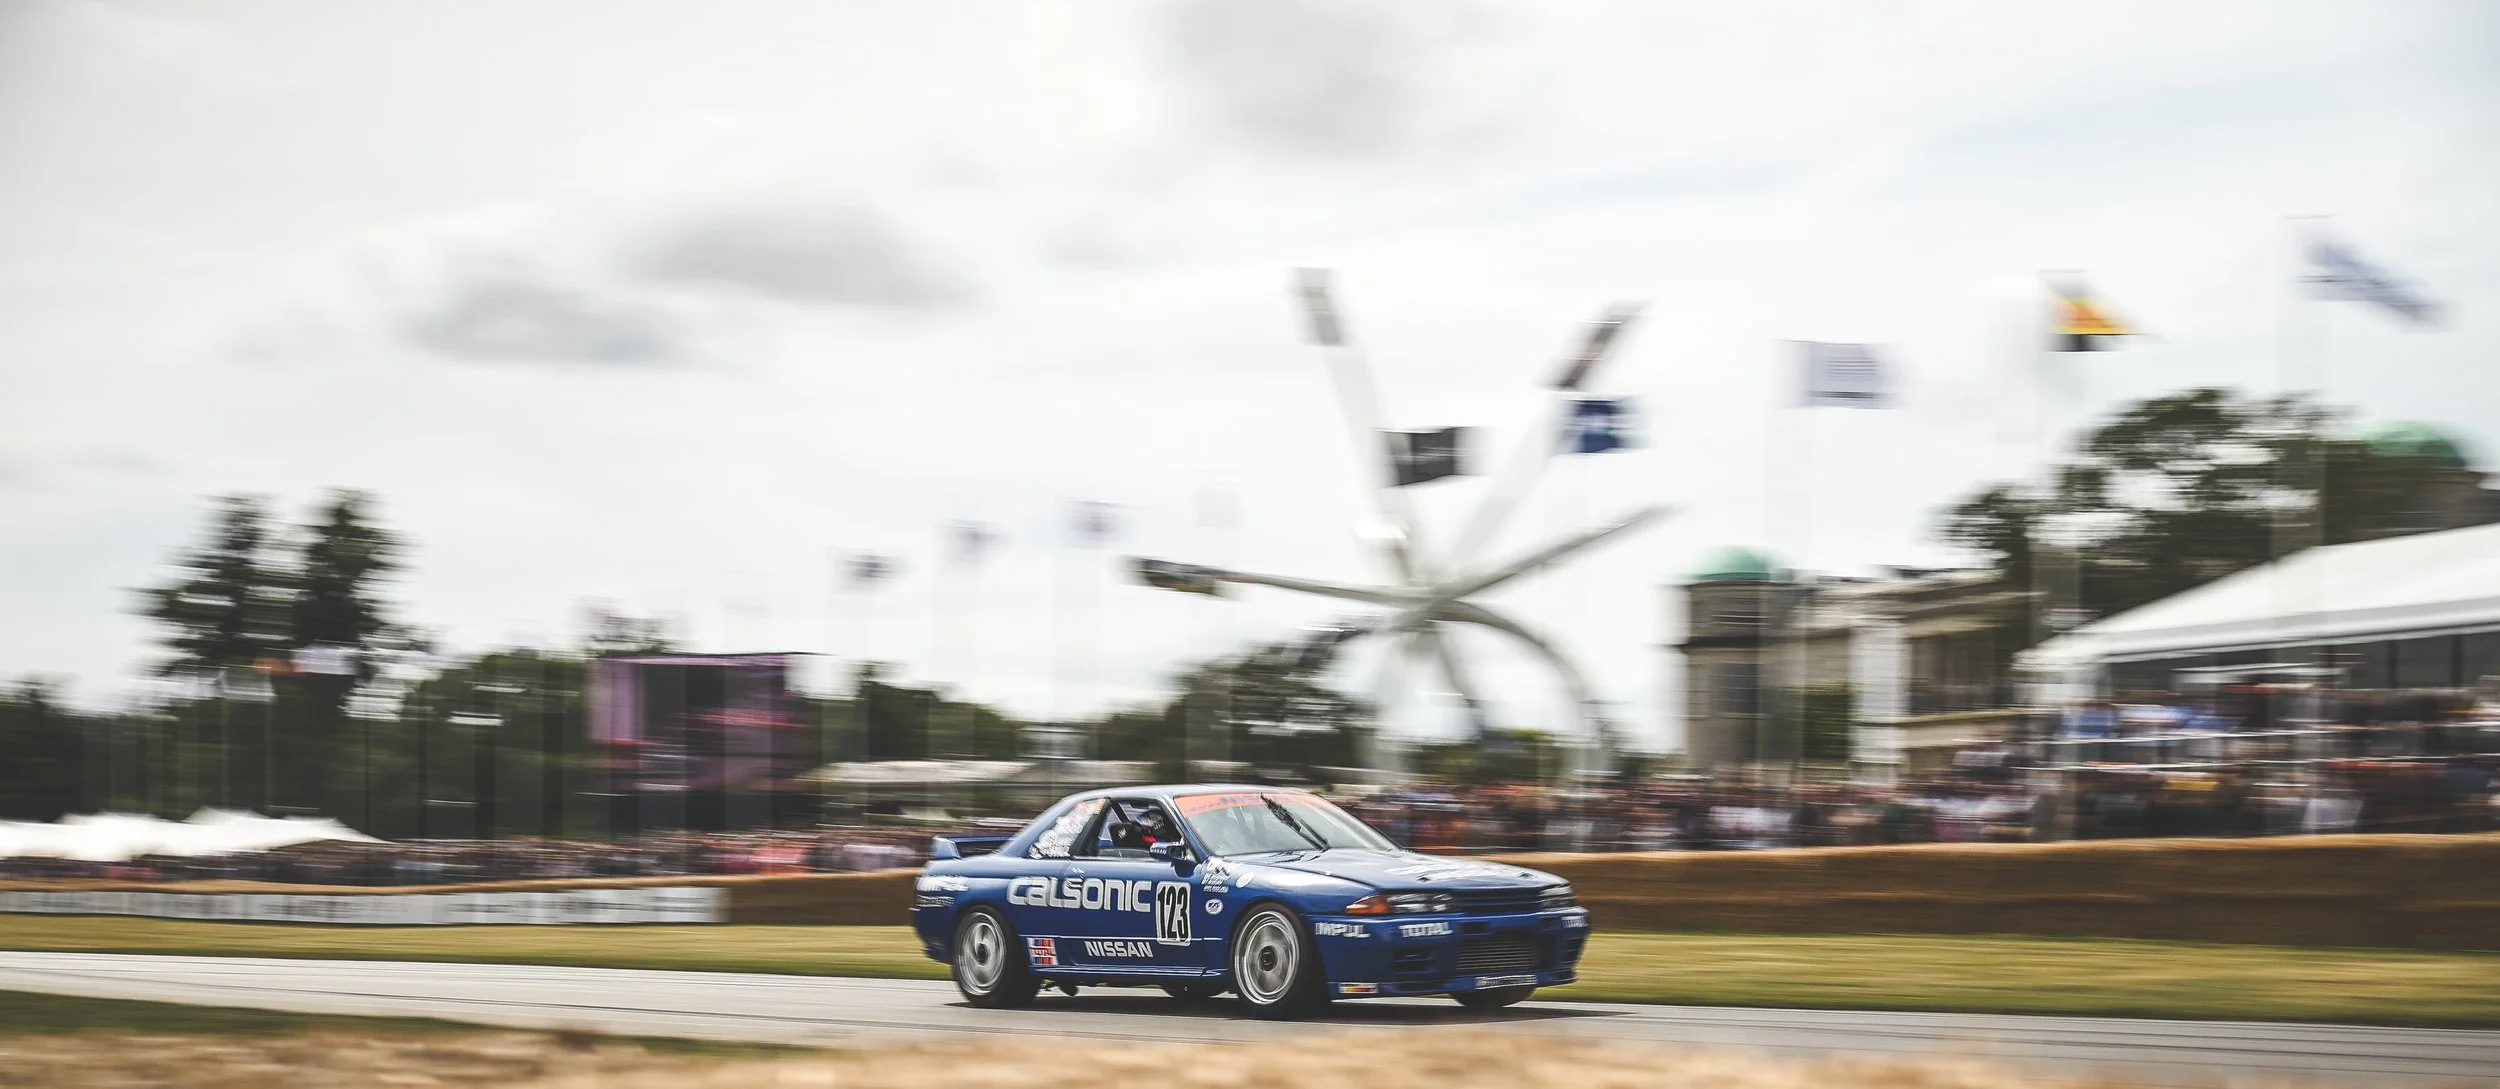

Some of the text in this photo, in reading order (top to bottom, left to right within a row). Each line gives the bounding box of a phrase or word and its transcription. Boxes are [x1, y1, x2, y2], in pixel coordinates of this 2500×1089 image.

[1157, 886, 1189, 942] 123
[1398, 922, 1453, 937] TOTAL
[1084, 940, 1154, 957] NISSAN
